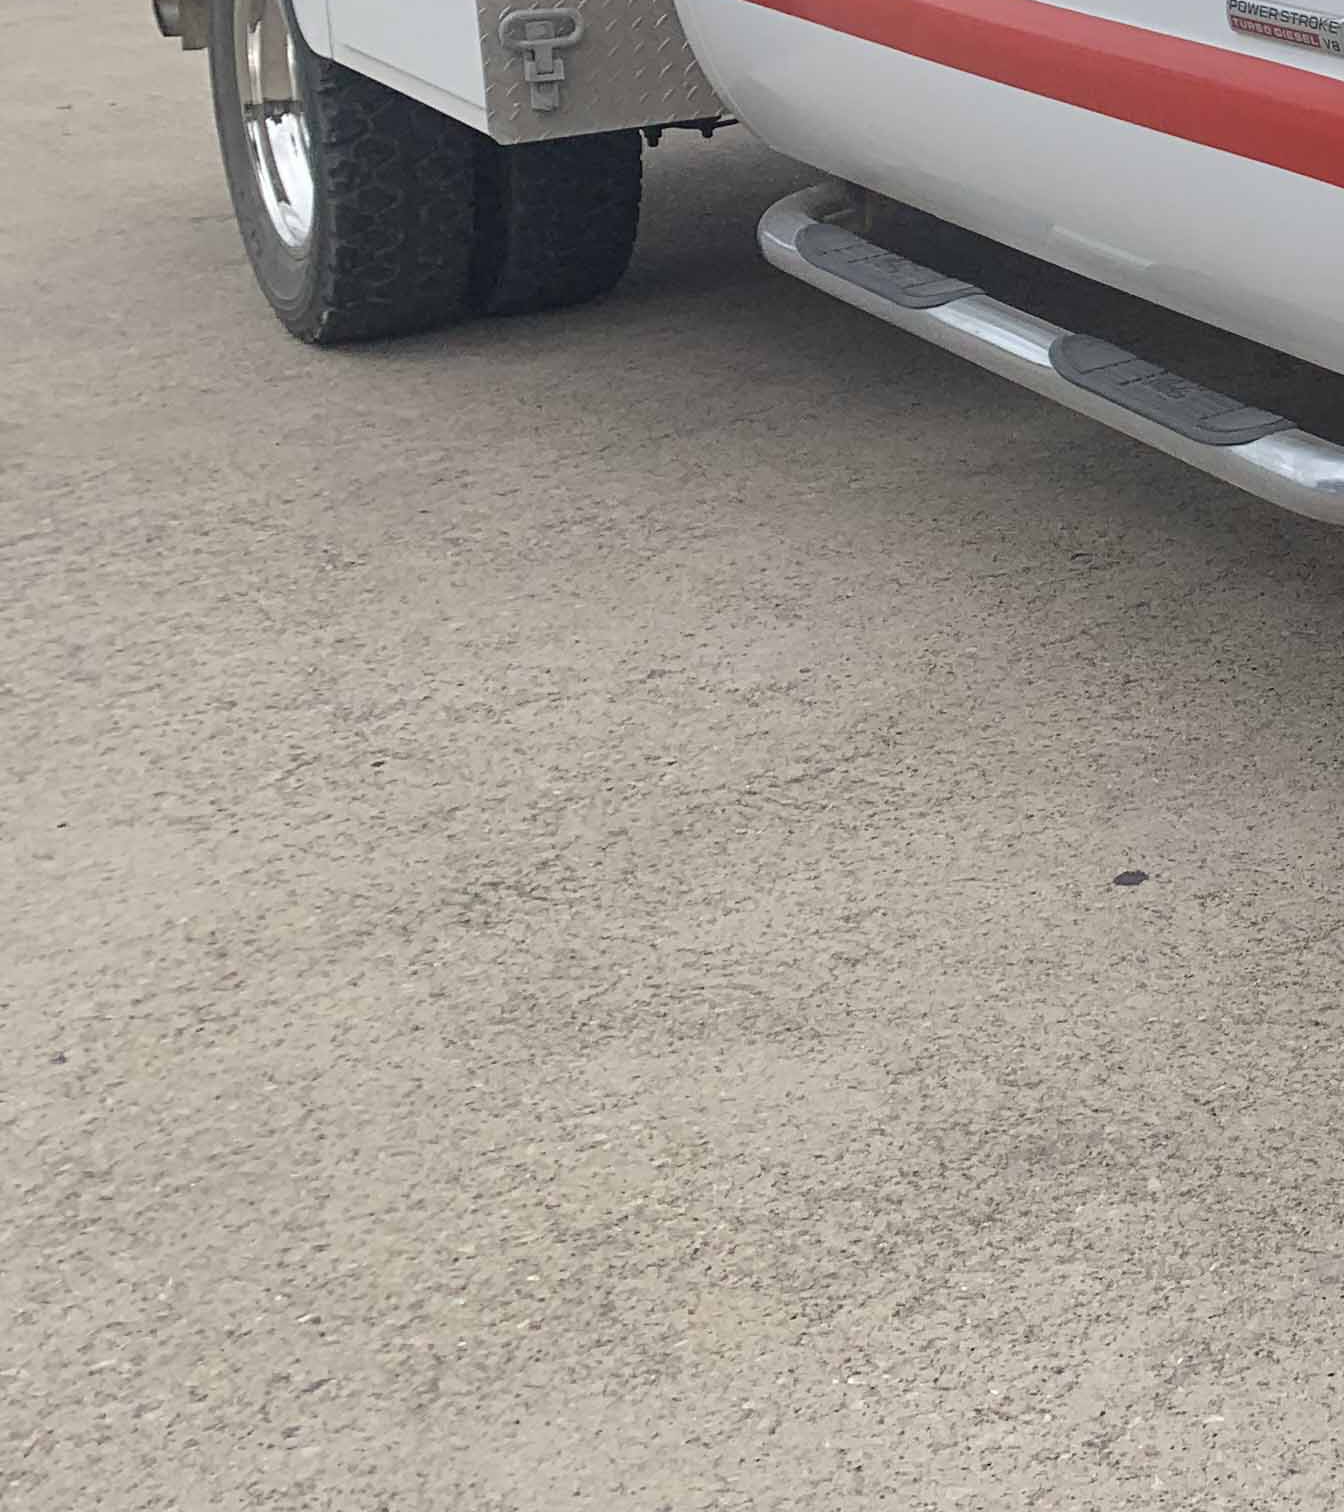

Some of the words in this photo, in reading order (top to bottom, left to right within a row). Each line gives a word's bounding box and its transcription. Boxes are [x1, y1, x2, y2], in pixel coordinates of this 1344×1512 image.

[1231, 17, 1272, 36] TURBO
[1273, 27, 1319, 47] DIESEL
[1322, 39, 1341, 53] V8
